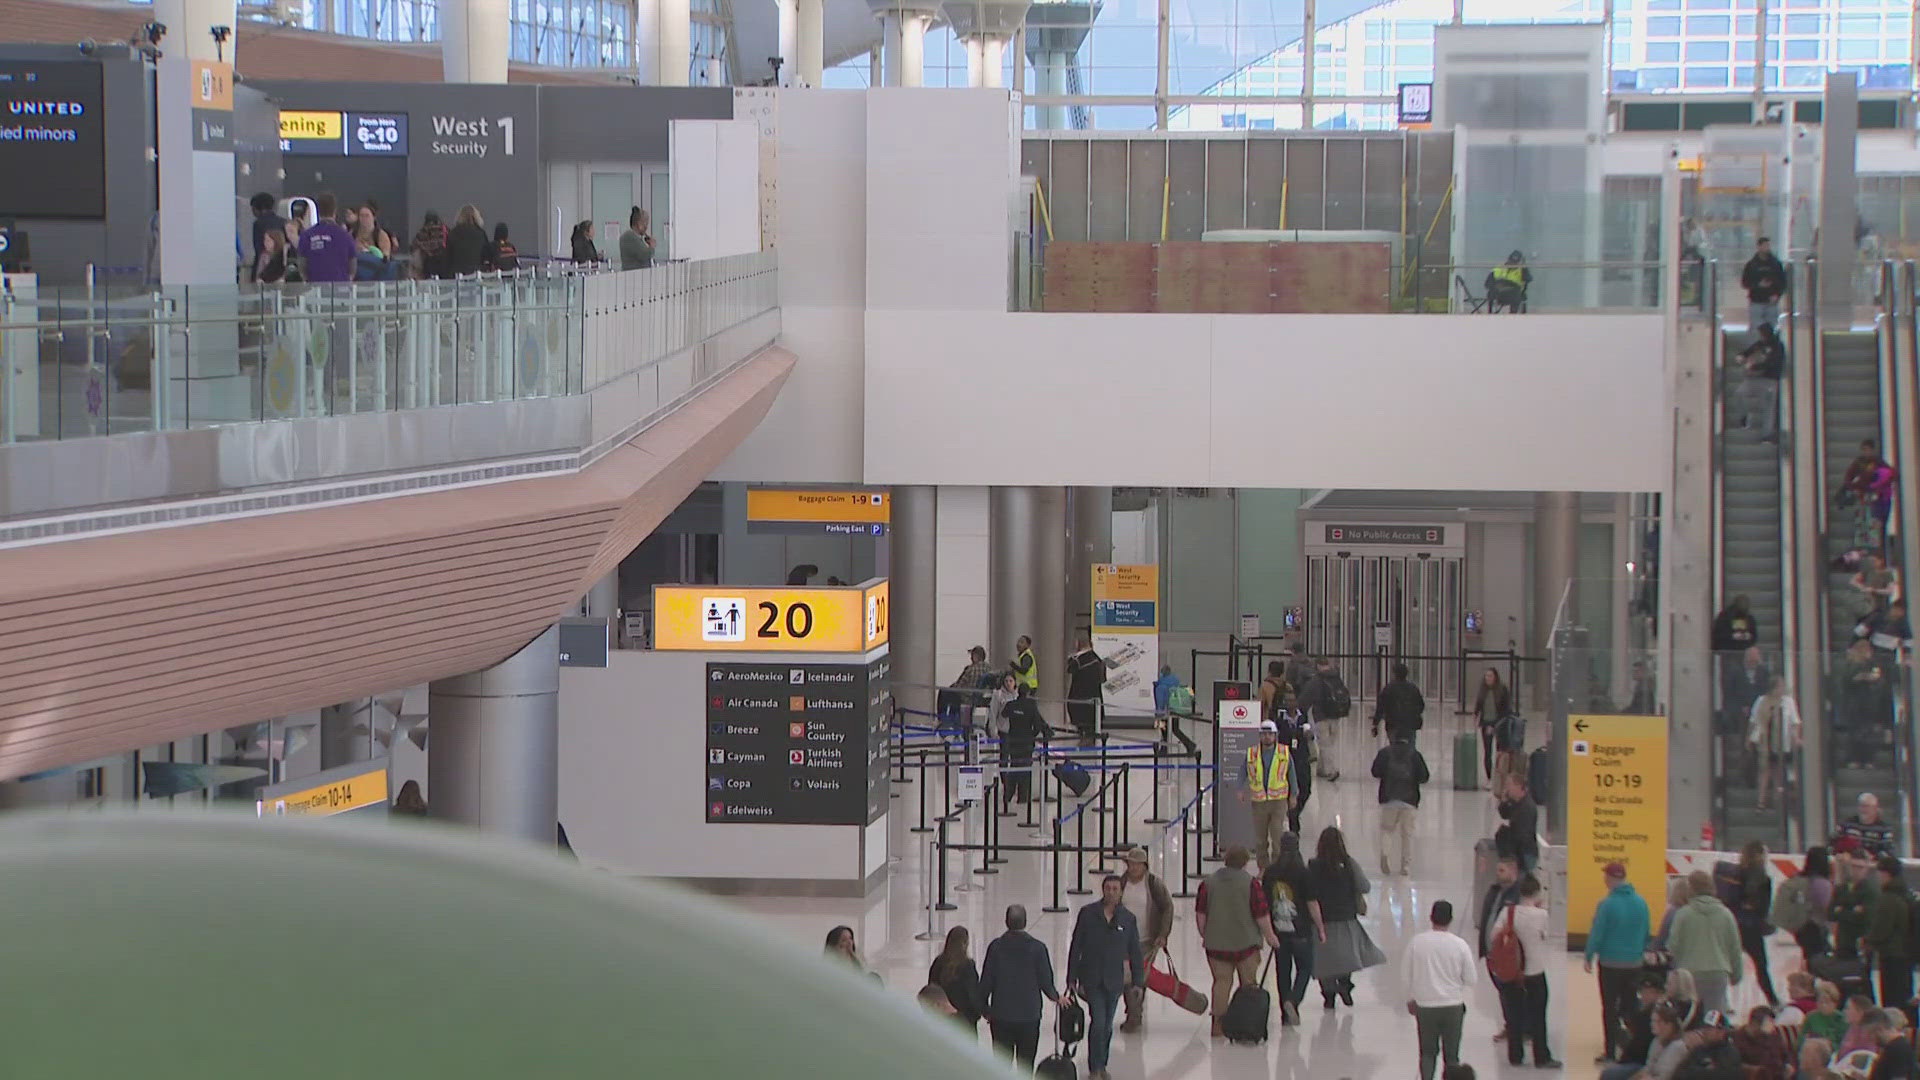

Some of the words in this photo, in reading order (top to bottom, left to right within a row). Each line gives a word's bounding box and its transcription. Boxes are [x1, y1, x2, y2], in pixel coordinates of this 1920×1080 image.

[8, 101, 83, 115] UNITED
[280, 117, 326, 136] ening
[432, 116, 488, 136] West
[25, 125, 77, 141] minors
[357, 127, 398, 143] 6-10
[497, 117, 514, 155] 1
[432, 141, 487, 158] Security
[798, 495, 825, 504] Baggage
[826, 495, 845, 503] Claim
[852, 495, 867, 504] 1-9
[826, 525, 850, 534] Parking
[851, 525, 865, 533] East
[1348, 530, 1361, 540] No
[1363, 530, 1390, 540] Public
[1392, 531, 1421, 540] Access
[876, 594, 885, 634] 20
[758, 602, 813, 639] 20
[728, 671, 784, 682] AeroMexico
[808, 671, 854, 683] Icelandair
[728, 698, 744, 708] Air
[744, 698, 778, 709] Canada
[807, 699, 854, 710] Lufthansa
[727, 724, 759, 735] Breeze
[807, 721, 825, 731] Sun
[807, 731, 845, 743] Country
[807, 748, 842, 758] Turkish
[1593, 744, 1635, 756] Baggage
[727, 752, 765, 764] Cayman
[807, 758, 843, 768] Airlines
[1593, 757, 1622, 766] Claim
[727, 778, 751, 790] Copa
[807, 779, 840, 790] Volaris
[1594, 774, 1642, 788] 10-19
[311, 794, 328, 808] Claim
[328, 784, 352, 807] 10-14
[1609, 796, 1643, 804] Canada
[727, 804, 773, 816] Edelweiss
[1613, 832, 1648, 842] Country
